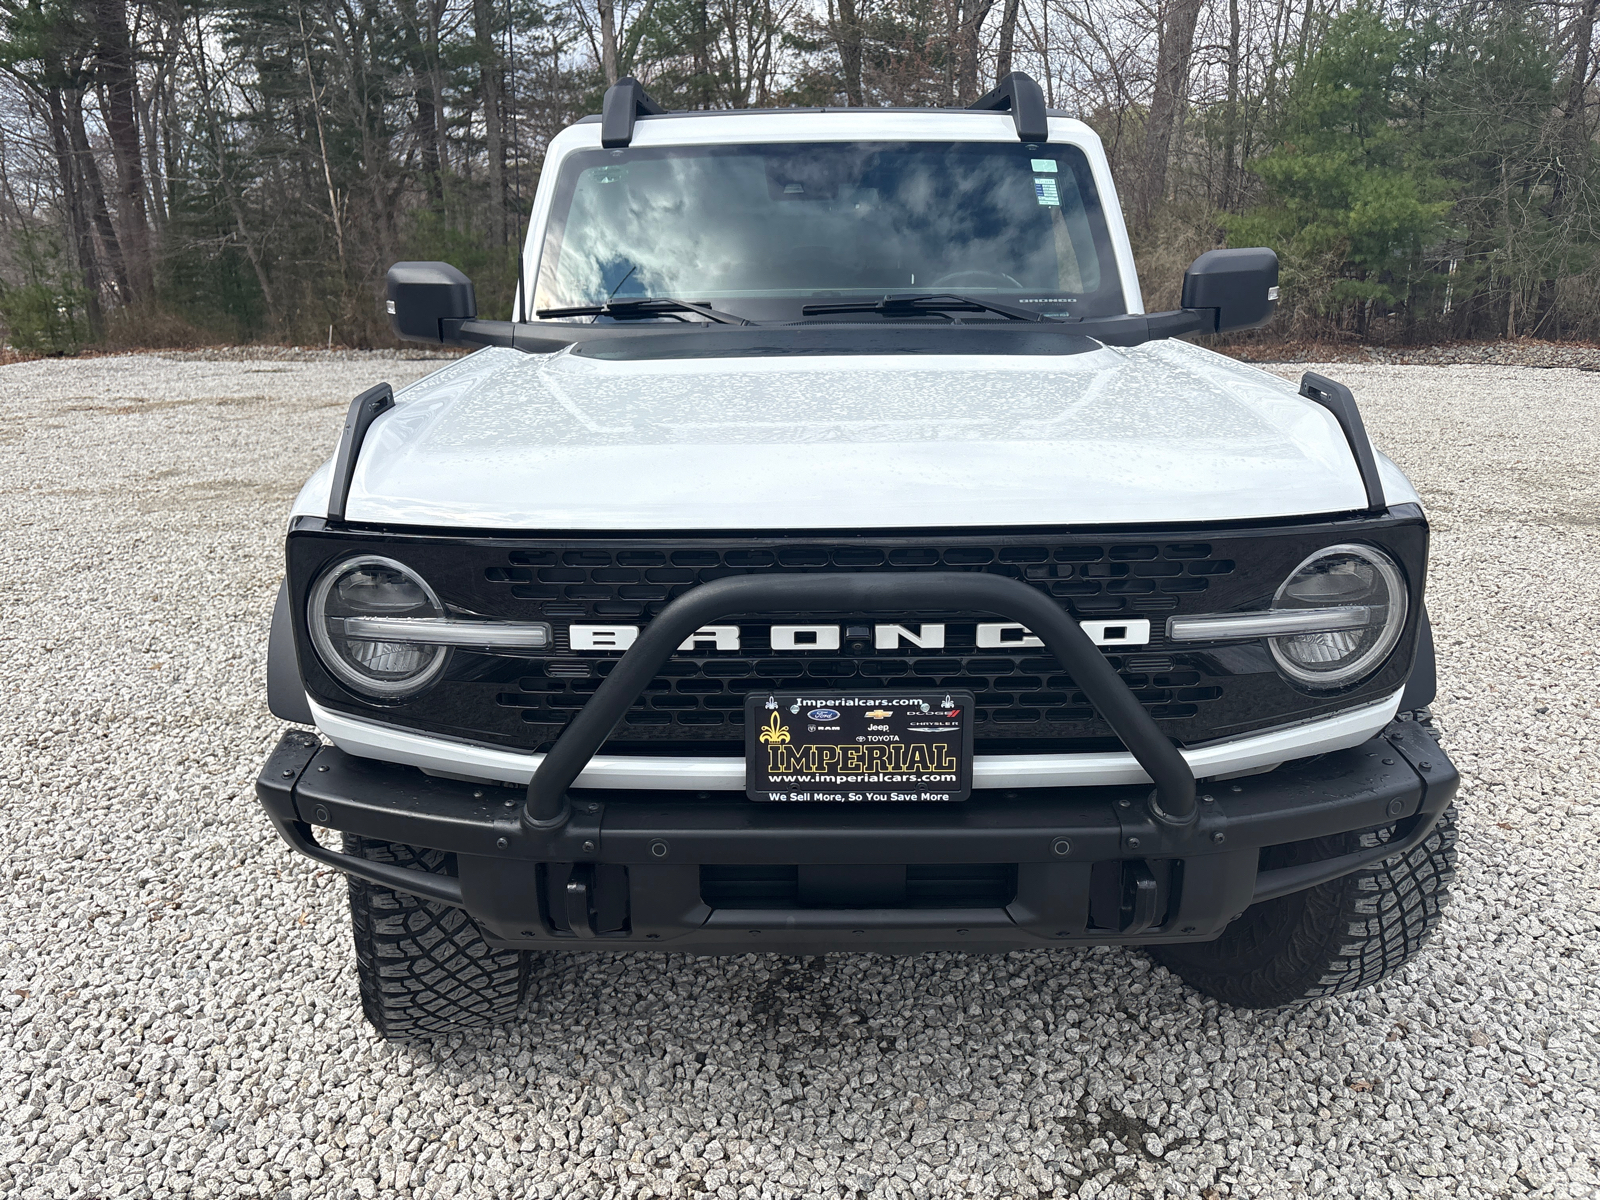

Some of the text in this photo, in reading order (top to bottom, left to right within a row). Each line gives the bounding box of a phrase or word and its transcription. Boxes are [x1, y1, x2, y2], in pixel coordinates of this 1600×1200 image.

[569, 618, 1150, 651] BRONCO
[796, 697, 923, 708] Imperialcars.com
[867, 723, 890, 733] Jeep
[768, 743, 956, 773] IMPERIAL
[768, 773, 957, 784] www.imperialcars.com
[769, 792, 950, 803] We Sell More, So You Save More
